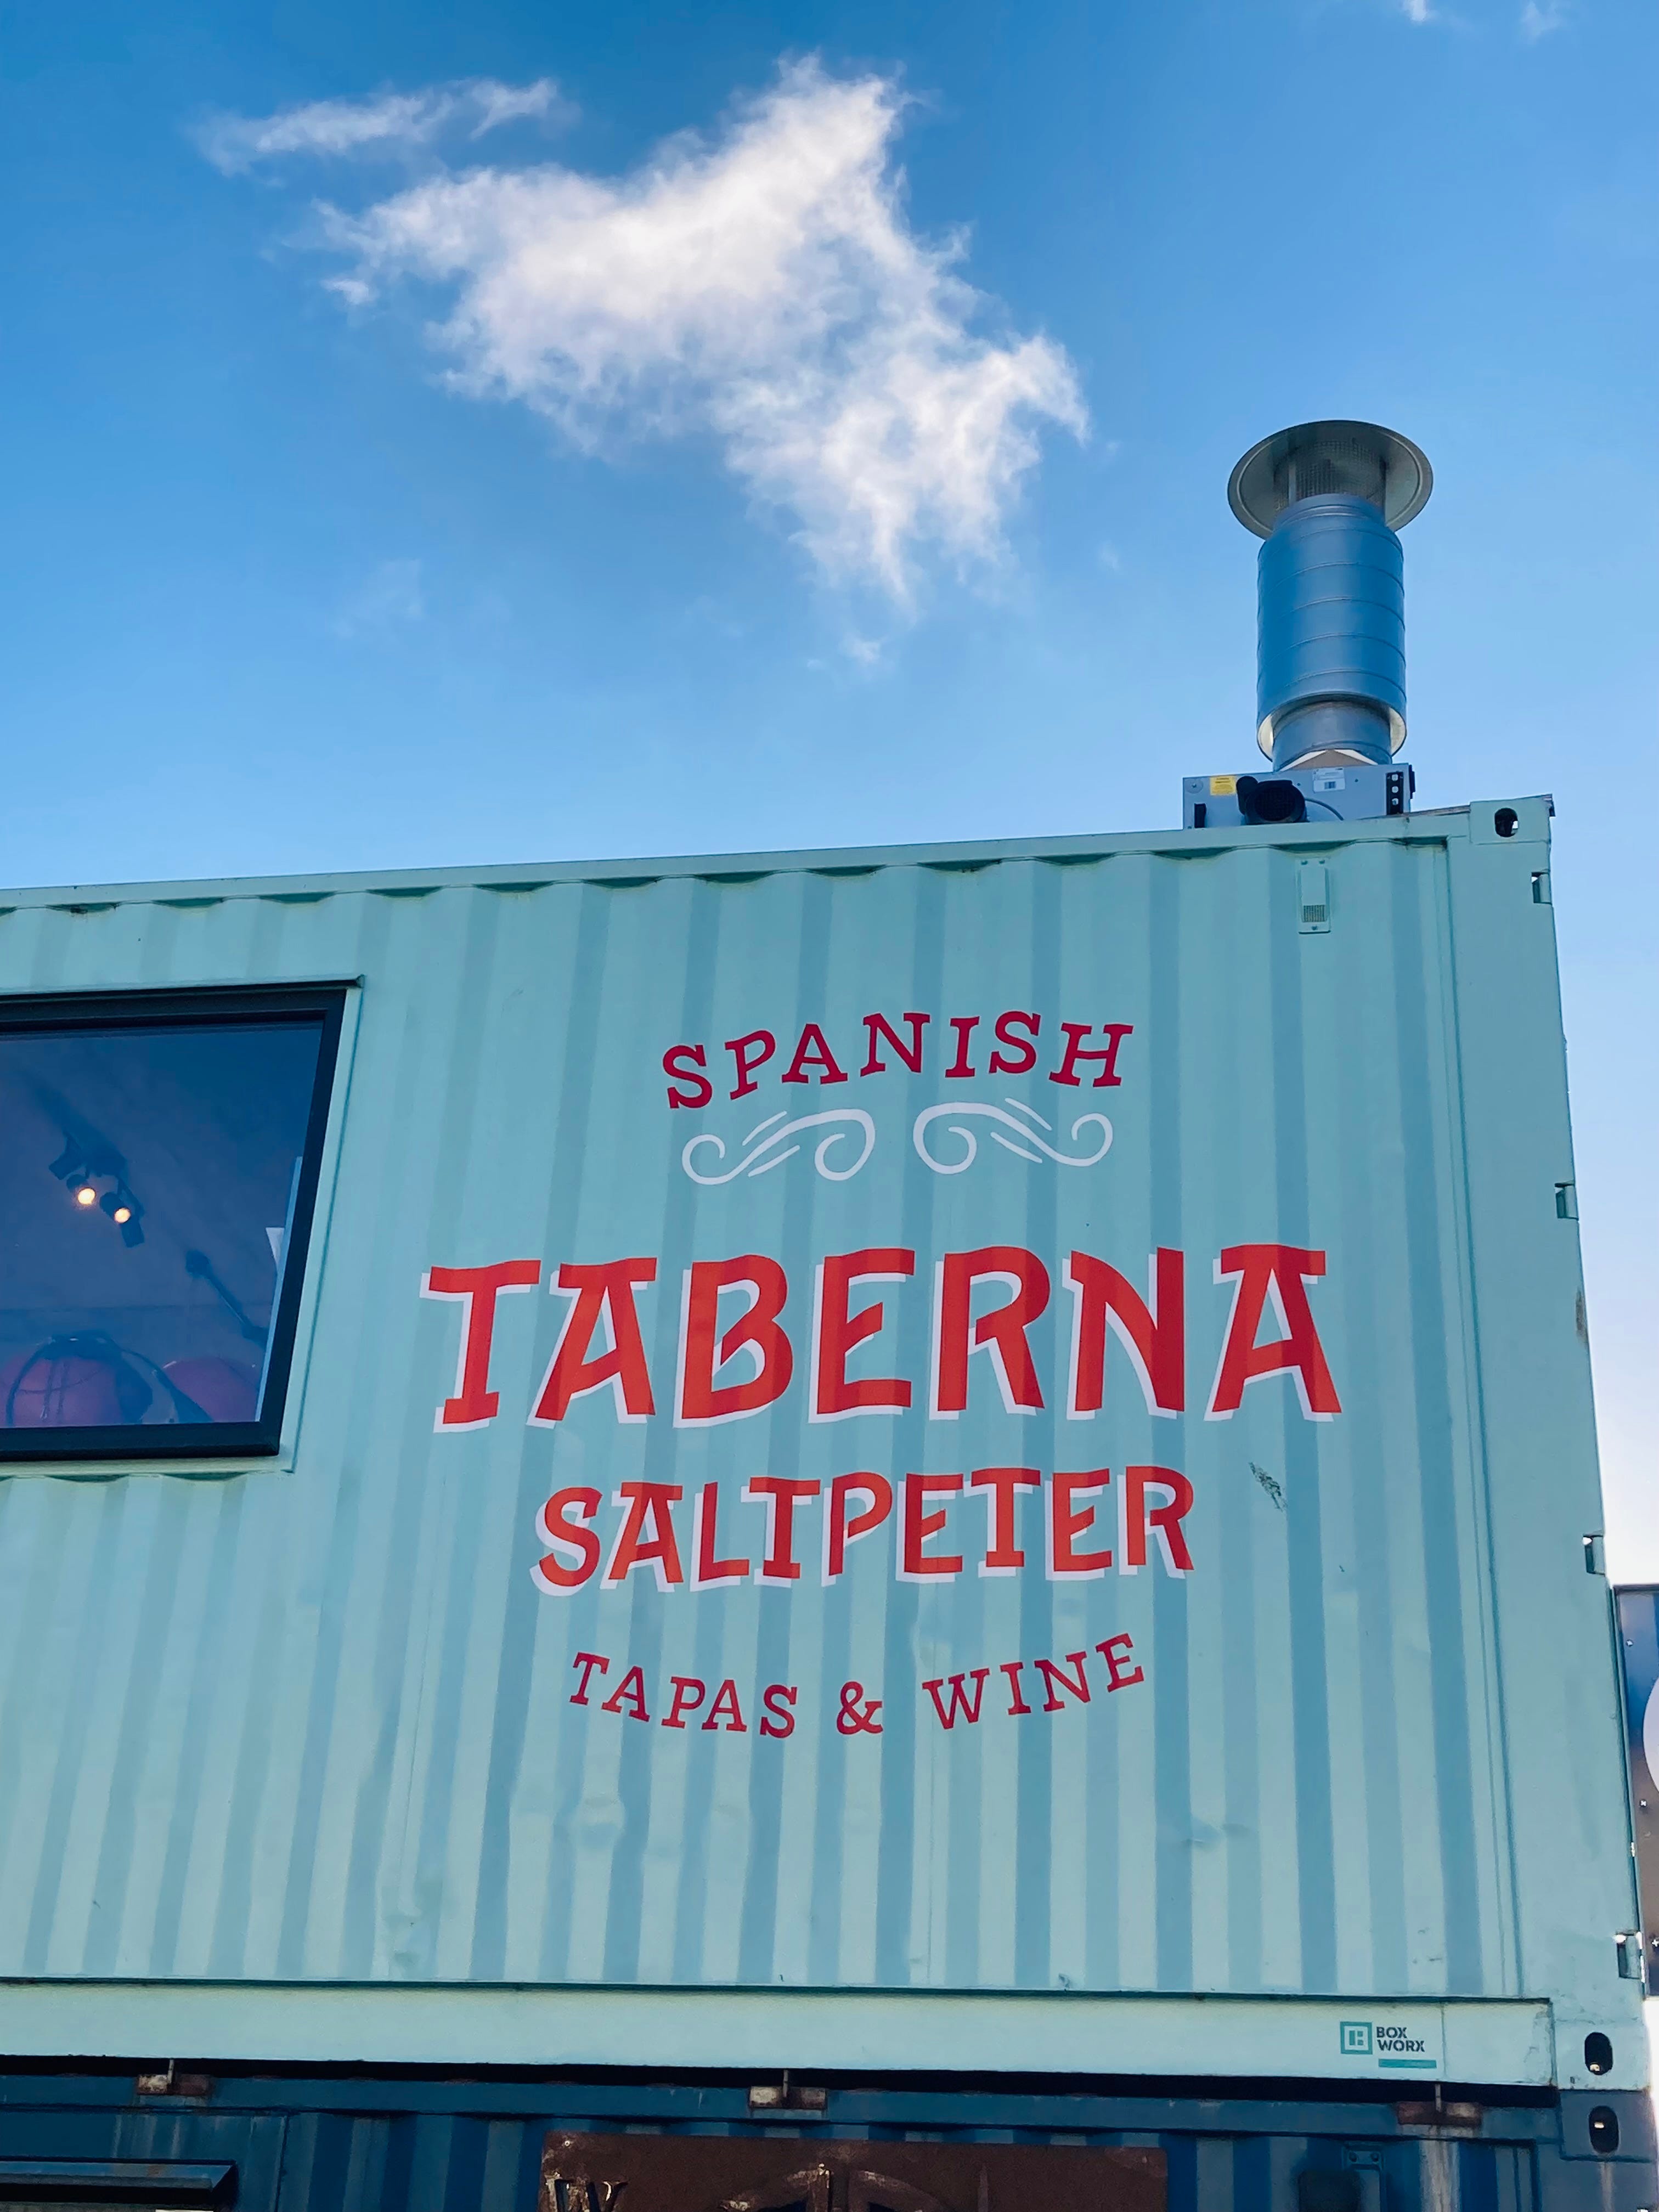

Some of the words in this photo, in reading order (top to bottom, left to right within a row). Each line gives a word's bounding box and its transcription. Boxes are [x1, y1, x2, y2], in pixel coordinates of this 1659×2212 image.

[663, 1011, 1133, 1109] SPANISH
[420, 1243, 1342, 1433] TABERNA
[531, 1465, 1194, 1595] SALTPETER
[569, 1652, 798, 1739] TAPAS
[837, 1681, 883, 1735] &
[922, 1633, 1144, 1730] WINE
[1376, 2026, 1407, 2038] BOX
[1377, 2039, 1425, 2052] WORX
